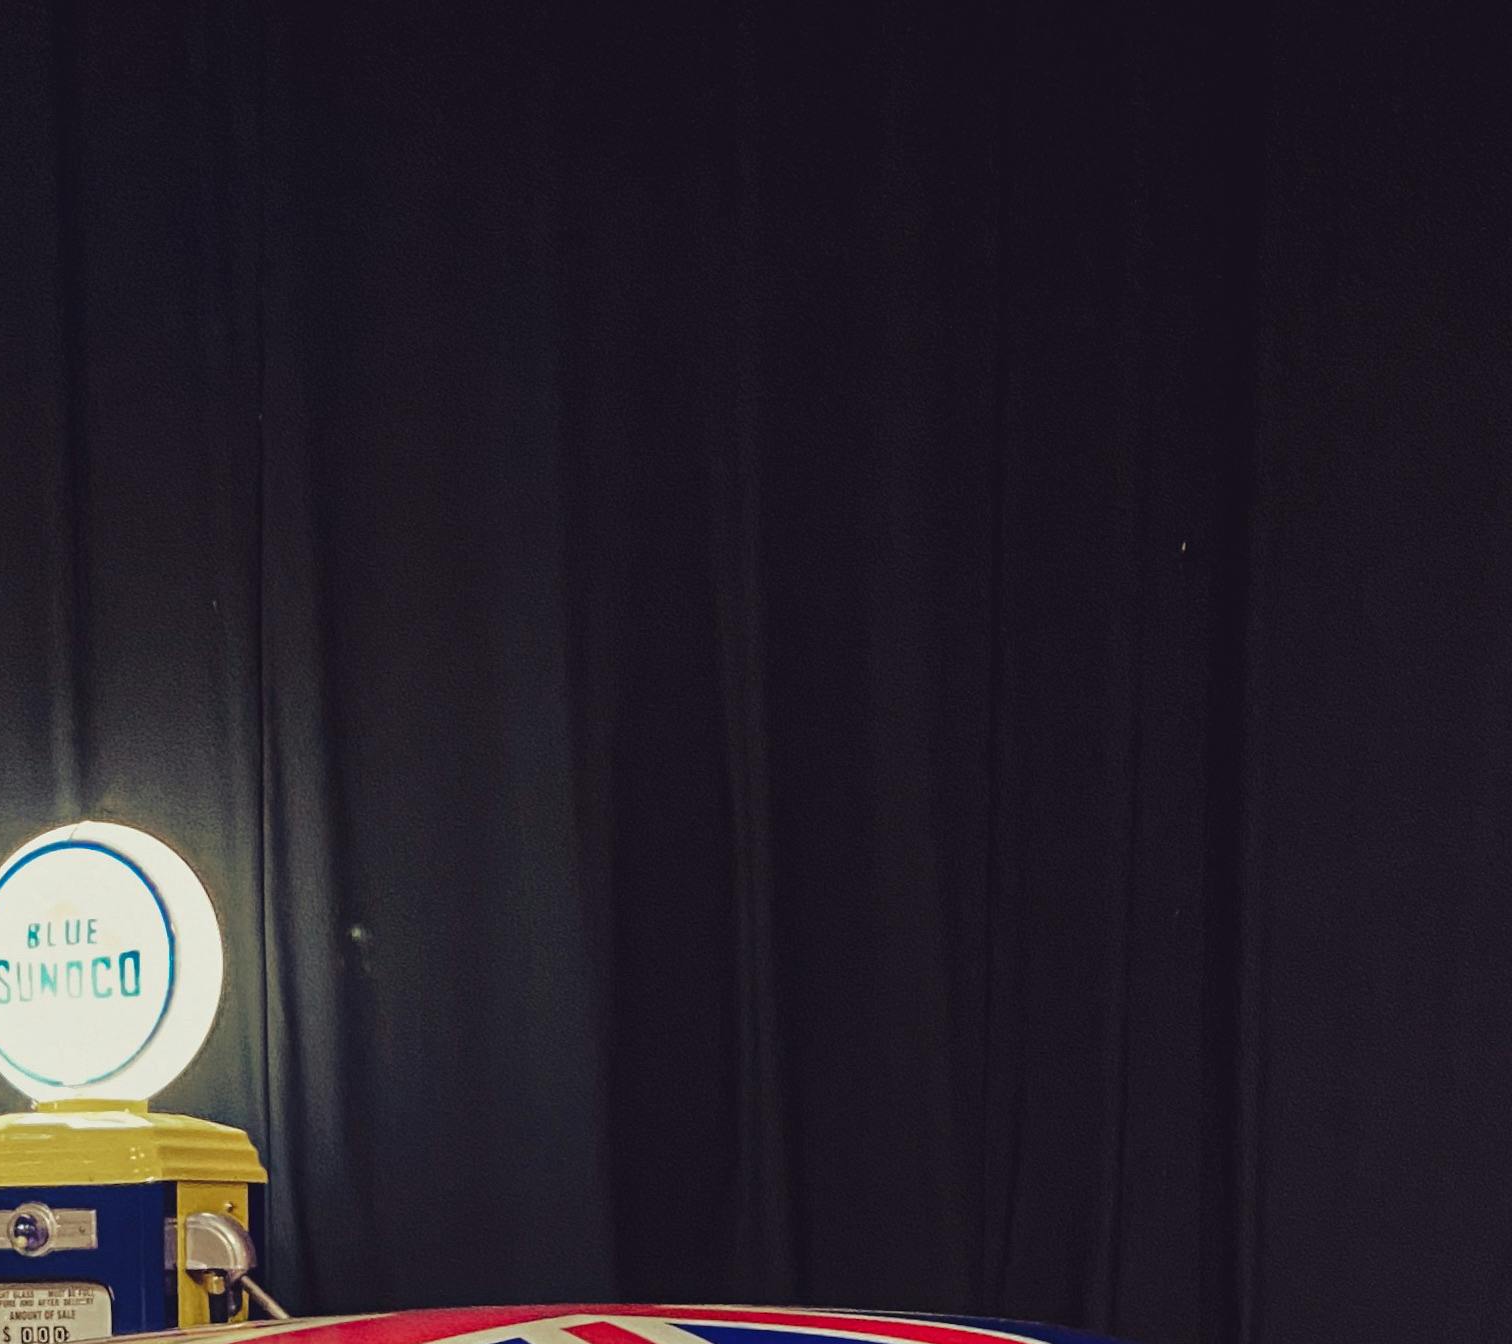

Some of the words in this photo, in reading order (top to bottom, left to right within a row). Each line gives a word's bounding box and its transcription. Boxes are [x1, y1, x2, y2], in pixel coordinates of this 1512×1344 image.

[27, 918, 98, 949] BLUE
[9, 1310, 42, 1320] AMOUNT
[44, 1310, 55, 1320] OF
[56, 1309, 76, 1320] SALE
[2, 1325, 12, 1343] $
